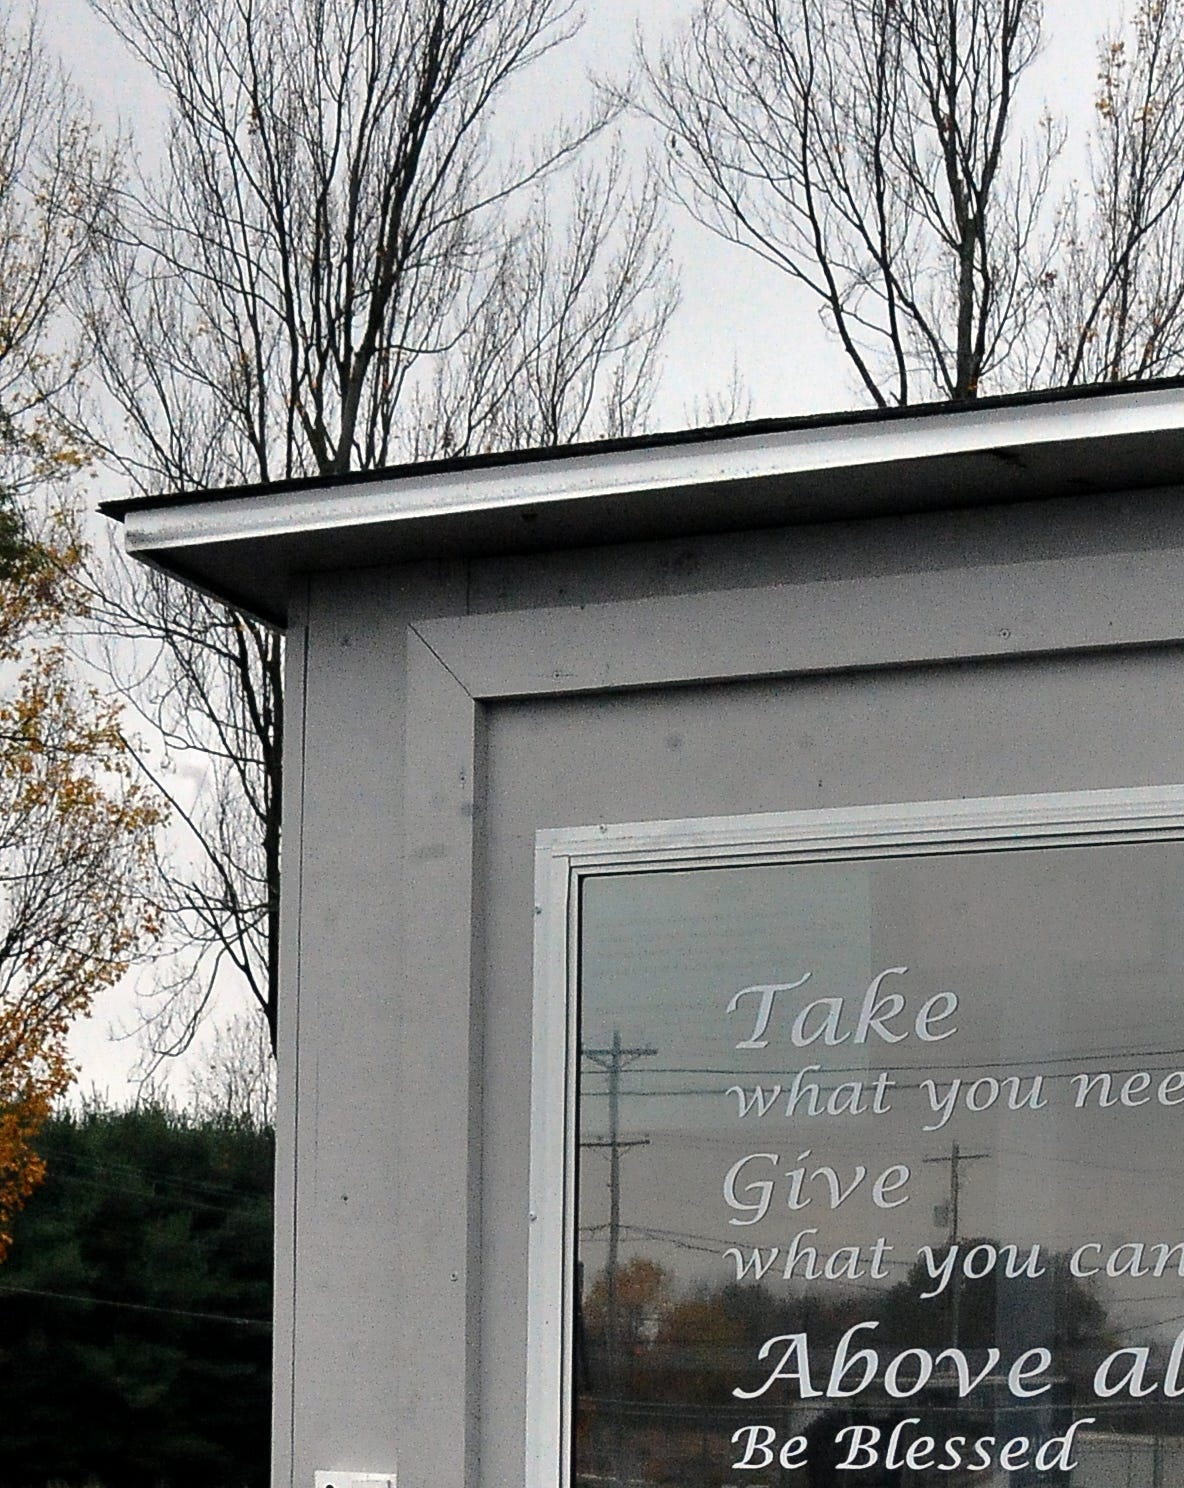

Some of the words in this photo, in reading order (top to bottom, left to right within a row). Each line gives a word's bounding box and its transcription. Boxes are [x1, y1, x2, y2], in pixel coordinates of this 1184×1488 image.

[726, 967, 959, 1048] Take
[725, 1065, 896, 1119] what
[921, 1072, 1048, 1131] you
[722, 1150, 911, 1226] Give
[722, 1230, 894, 1281] what
[916, 1241, 1046, 1299] you
[733, 1321, 1053, 1401] Above
[731, 1425, 809, 1471] Be
[834, 1418, 1097, 1473] Blessed
